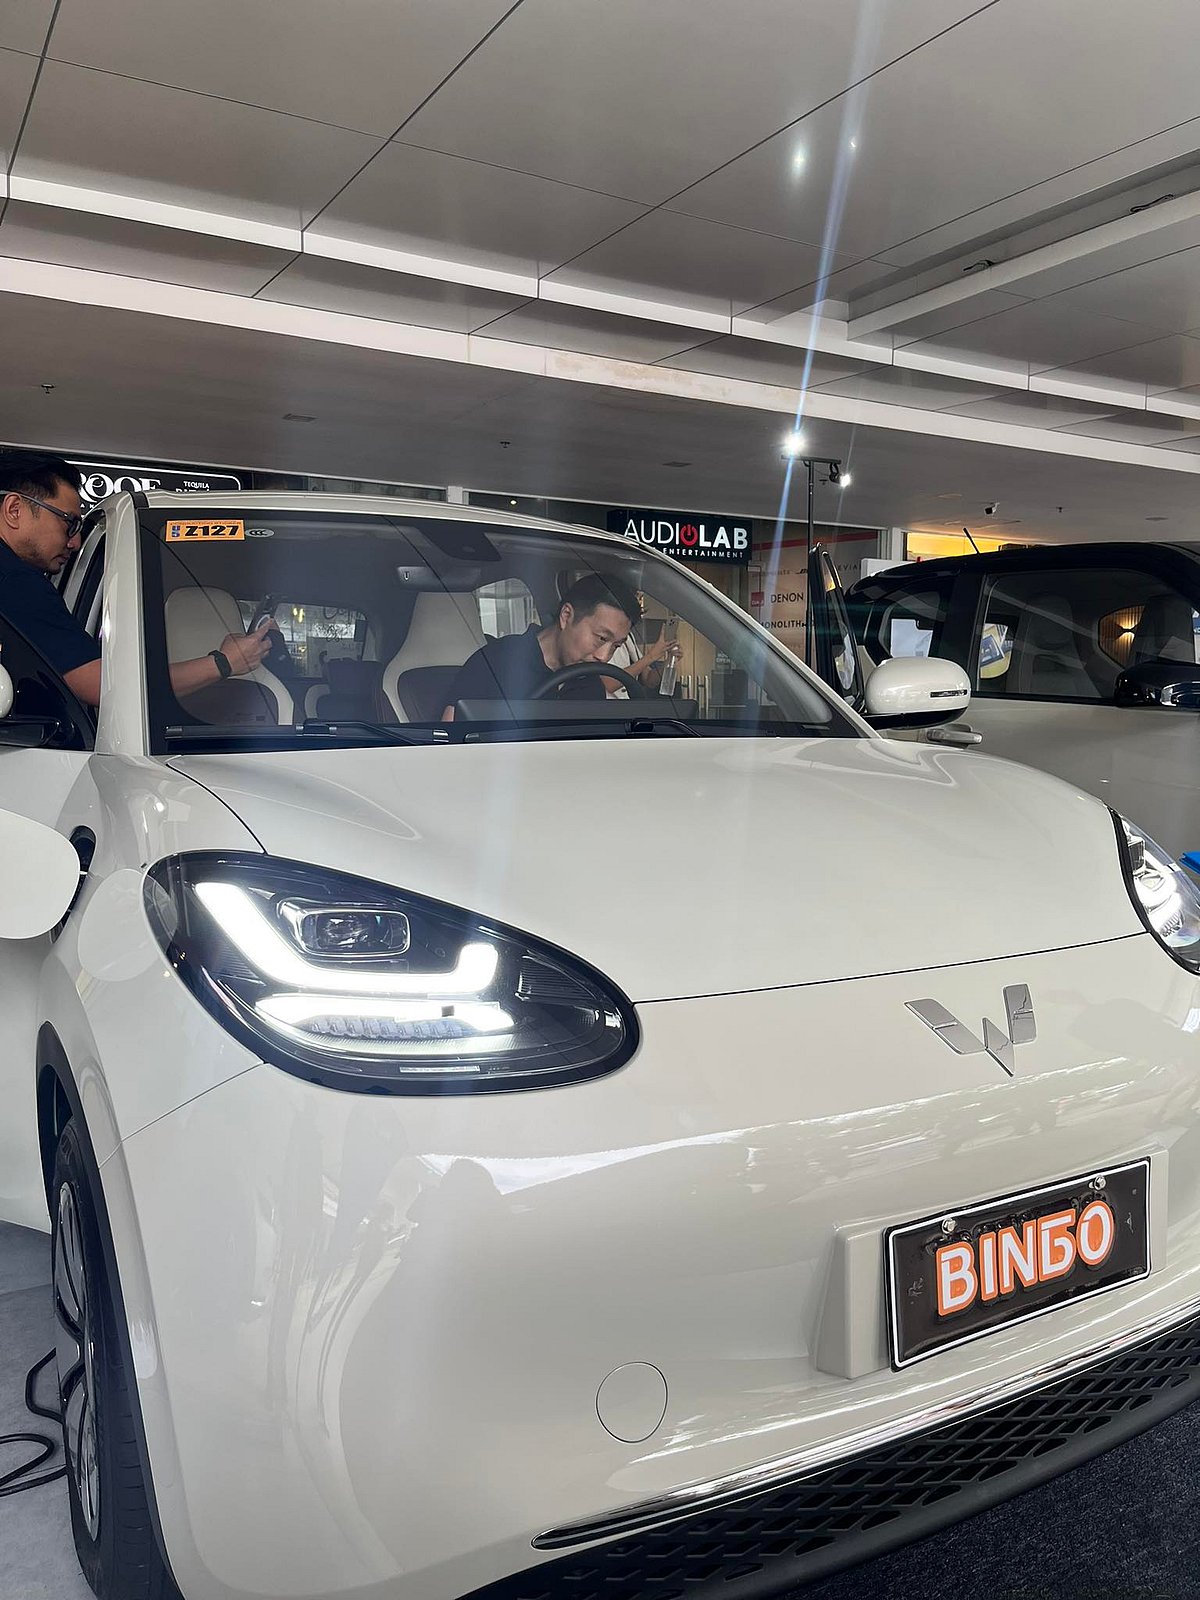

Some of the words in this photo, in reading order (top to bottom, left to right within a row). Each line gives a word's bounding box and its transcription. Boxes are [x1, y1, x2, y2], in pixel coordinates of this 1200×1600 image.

[183, 480, 210, 489] TEQUILA
[185, 525, 239, 537] Z127
[624, 518, 748, 550] AUDIOLAB
[663, 547, 744, 559] ENTERTAINMENT
[770, 592, 804, 604] DENON
[936, 1200, 1115, 1316] BINGO
